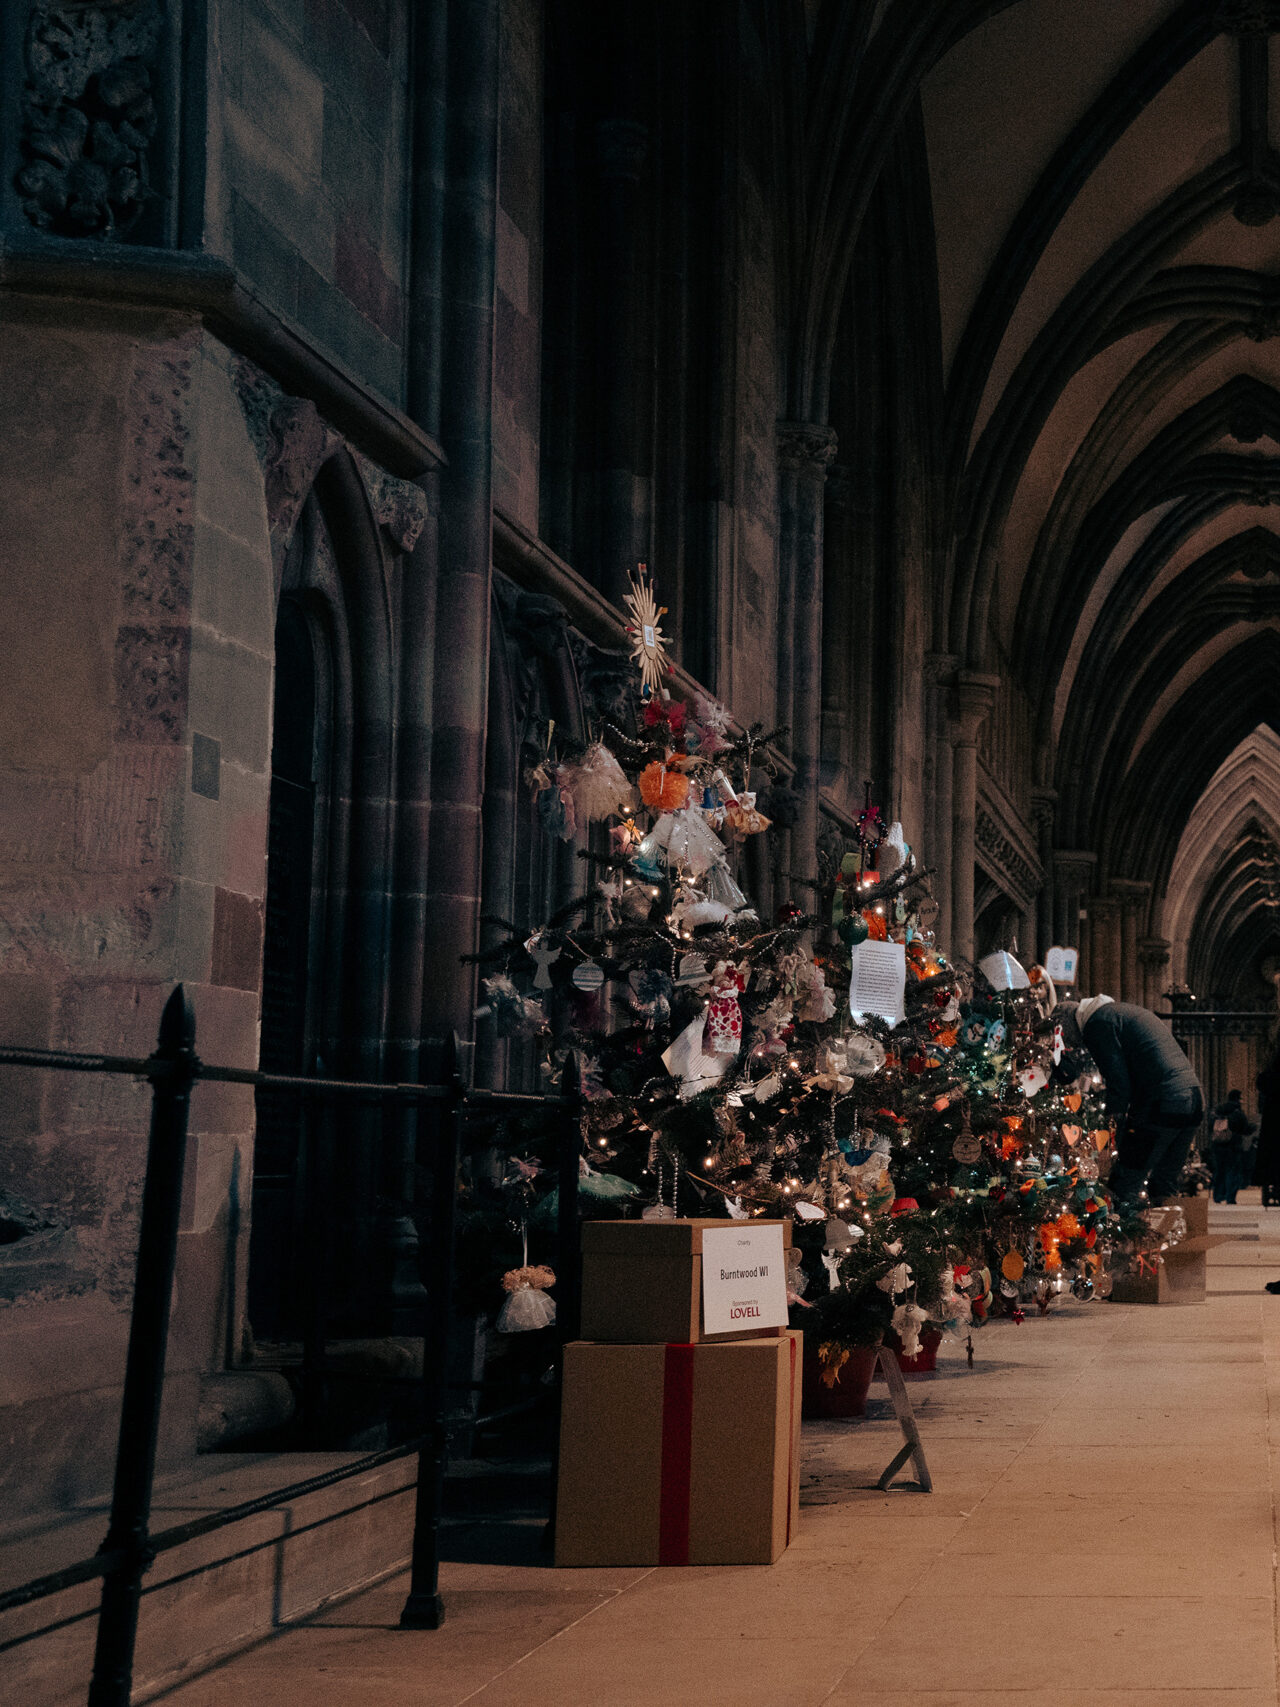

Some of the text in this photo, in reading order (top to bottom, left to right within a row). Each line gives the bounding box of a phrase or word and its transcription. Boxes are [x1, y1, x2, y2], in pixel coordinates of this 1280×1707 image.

[720, 1266, 769, 1280] Burntwood WI
[730, 1306, 761, 1319] LOVELL
